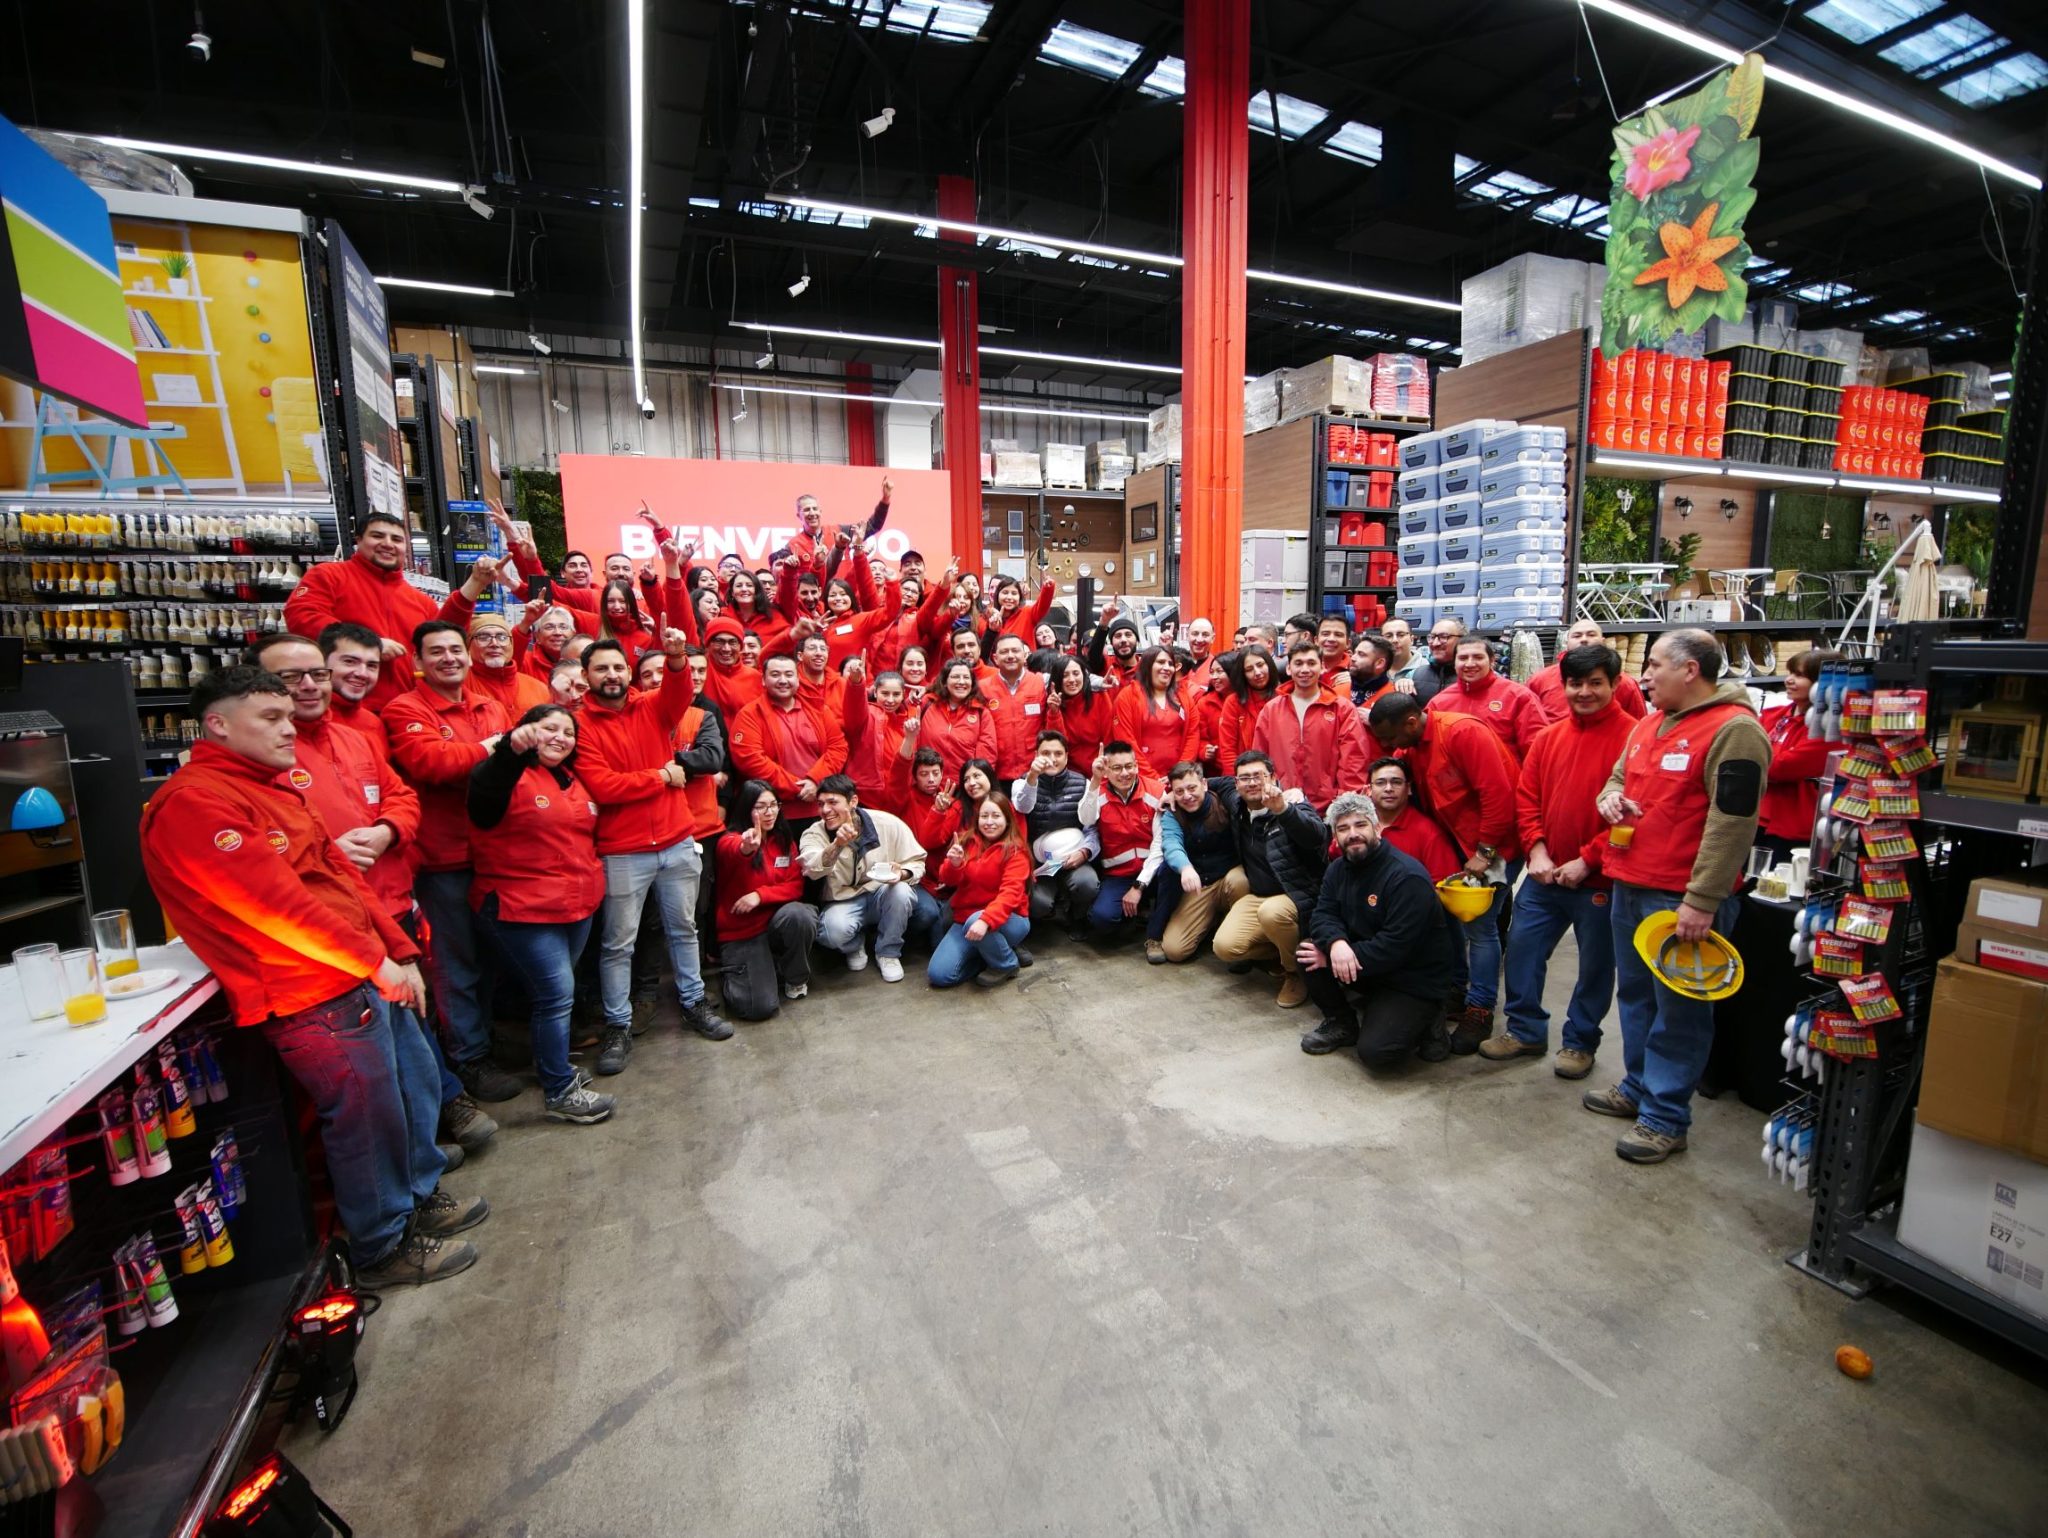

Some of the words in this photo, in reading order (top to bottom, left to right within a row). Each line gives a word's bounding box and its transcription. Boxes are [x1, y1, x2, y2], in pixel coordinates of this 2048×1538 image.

[1872, 780, 1911, 788] EVEREADY
[1847, 901, 1889, 915] EVEREADY
[1820, 938, 1858, 949] EVEREADY
[1990, 1225, 2012, 1243] E27
